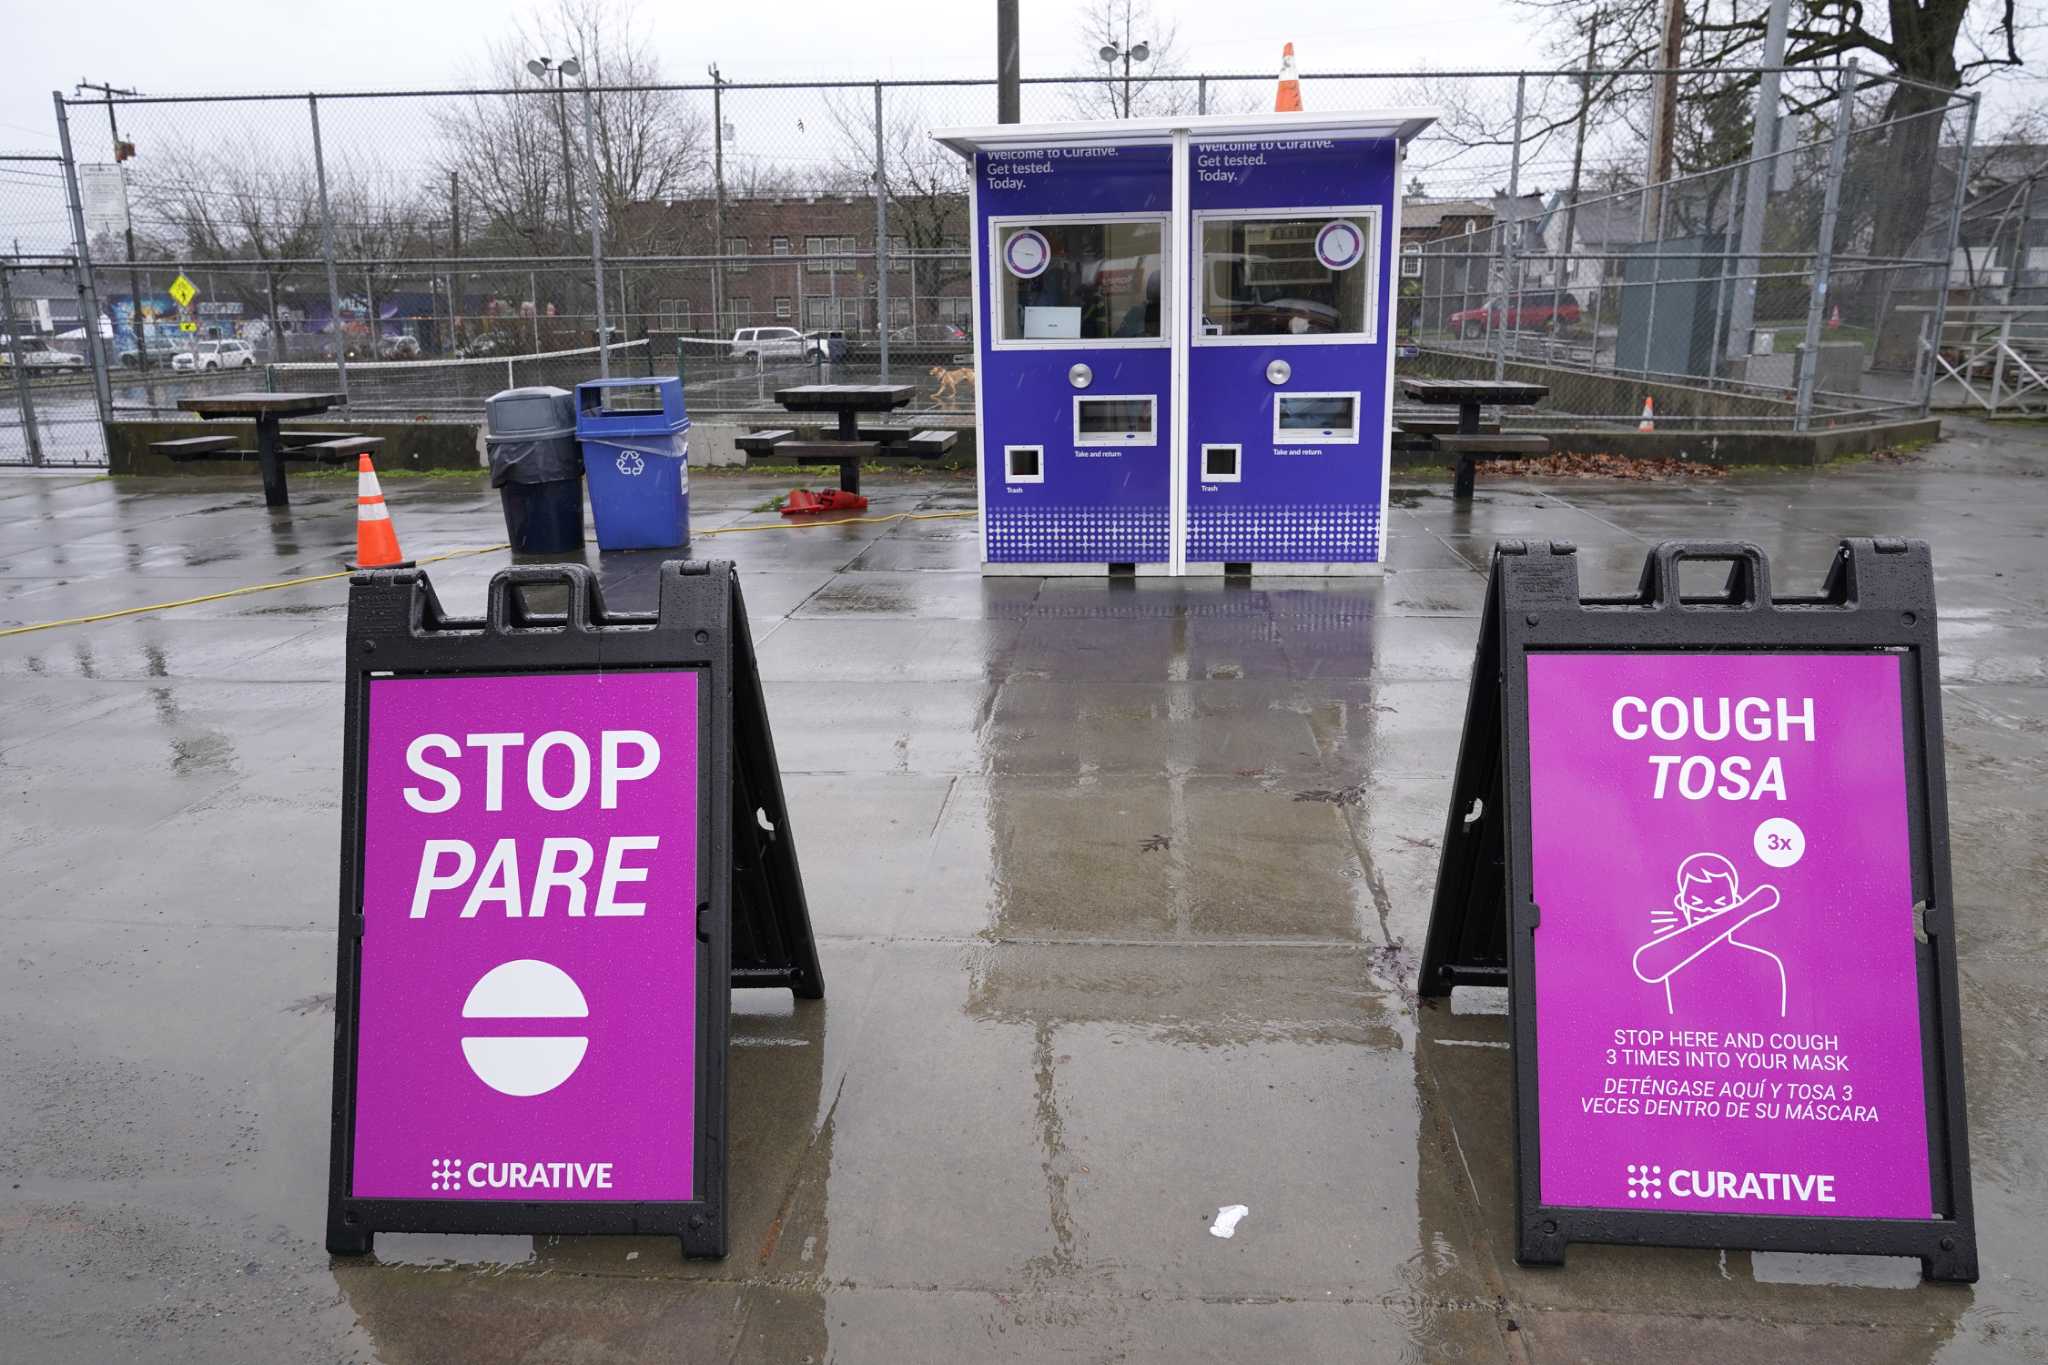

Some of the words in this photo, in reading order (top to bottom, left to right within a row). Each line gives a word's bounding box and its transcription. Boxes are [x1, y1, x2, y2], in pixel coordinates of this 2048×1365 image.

[987, 150, 1044, 160] Welcome
[1047, 148, 1061, 158] to
[1199, 142, 1257, 152] Welcome
[1260, 141, 1274, 151] to
[987, 163, 1010, 175] Get
[1012, 161, 1055, 174] tested.
[1197, 155, 1220, 167] Get
[1223, 153, 1267, 166] tested.
[987, 177, 1027, 190] Today.
[1197, 169, 1238, 183] Today.
[1074, 450, 1089, 458] Take
[1090, 450, 1102, 458] and
[1102, 450, 1122, 458] return
[1273, 448, 1288, 456] Take
[1289, 448, 1302, 456] and
[1006, 486, 1024, 494] Trash
[1201, 484, 1219, 492] Trash
[1612, 695, 1816, 742] COUGH
[403, 730, 661, 814] STOP
[1648, 755, 1787, 801] TOSA
[1767, 833, 1792, 851] 3x
[409, 835, 660, 919] PARE
[1614, 1029, 1664, 1046] STOP
[1669, 1030, 1719, 1048] HERE
[1724, 1032, 1764, 1049] AND
[1770, 1033, 1838, 1051] COUGH
[1606, 1048, 1617, 1065] 3
[1621, 1049, 1680, 1066] TIMES
[1686, 1051, 1730, 1068] INTO
[1735, 1052, 1788, 1070] YOUR
[1792, 1054, 1849, 1071] MASK
[1604, 1075, 1716, 1097] DETÉNGASE
[1718, 1078, 1767, 1100] AQUÍ
[1770, 1083, 1783, 1099] Y
[1787, 1083, 1836, 1101] TOSA
[1842, 1085, 1853, 1101] 3
[1581, 1097, 1640, 1115] VECES
[1644, 1099, 1720, 1117] DENTRO
[1725, 1101, 1750, 1118] DE
[1755, 1102, 1780, 1119] SU
[1785, 1101, 1879, 1122] MÁSCARA
[467, 1162, 613, 1188] CURATIVE
[1668, 1169, 1836, 1202] CURATIVE
